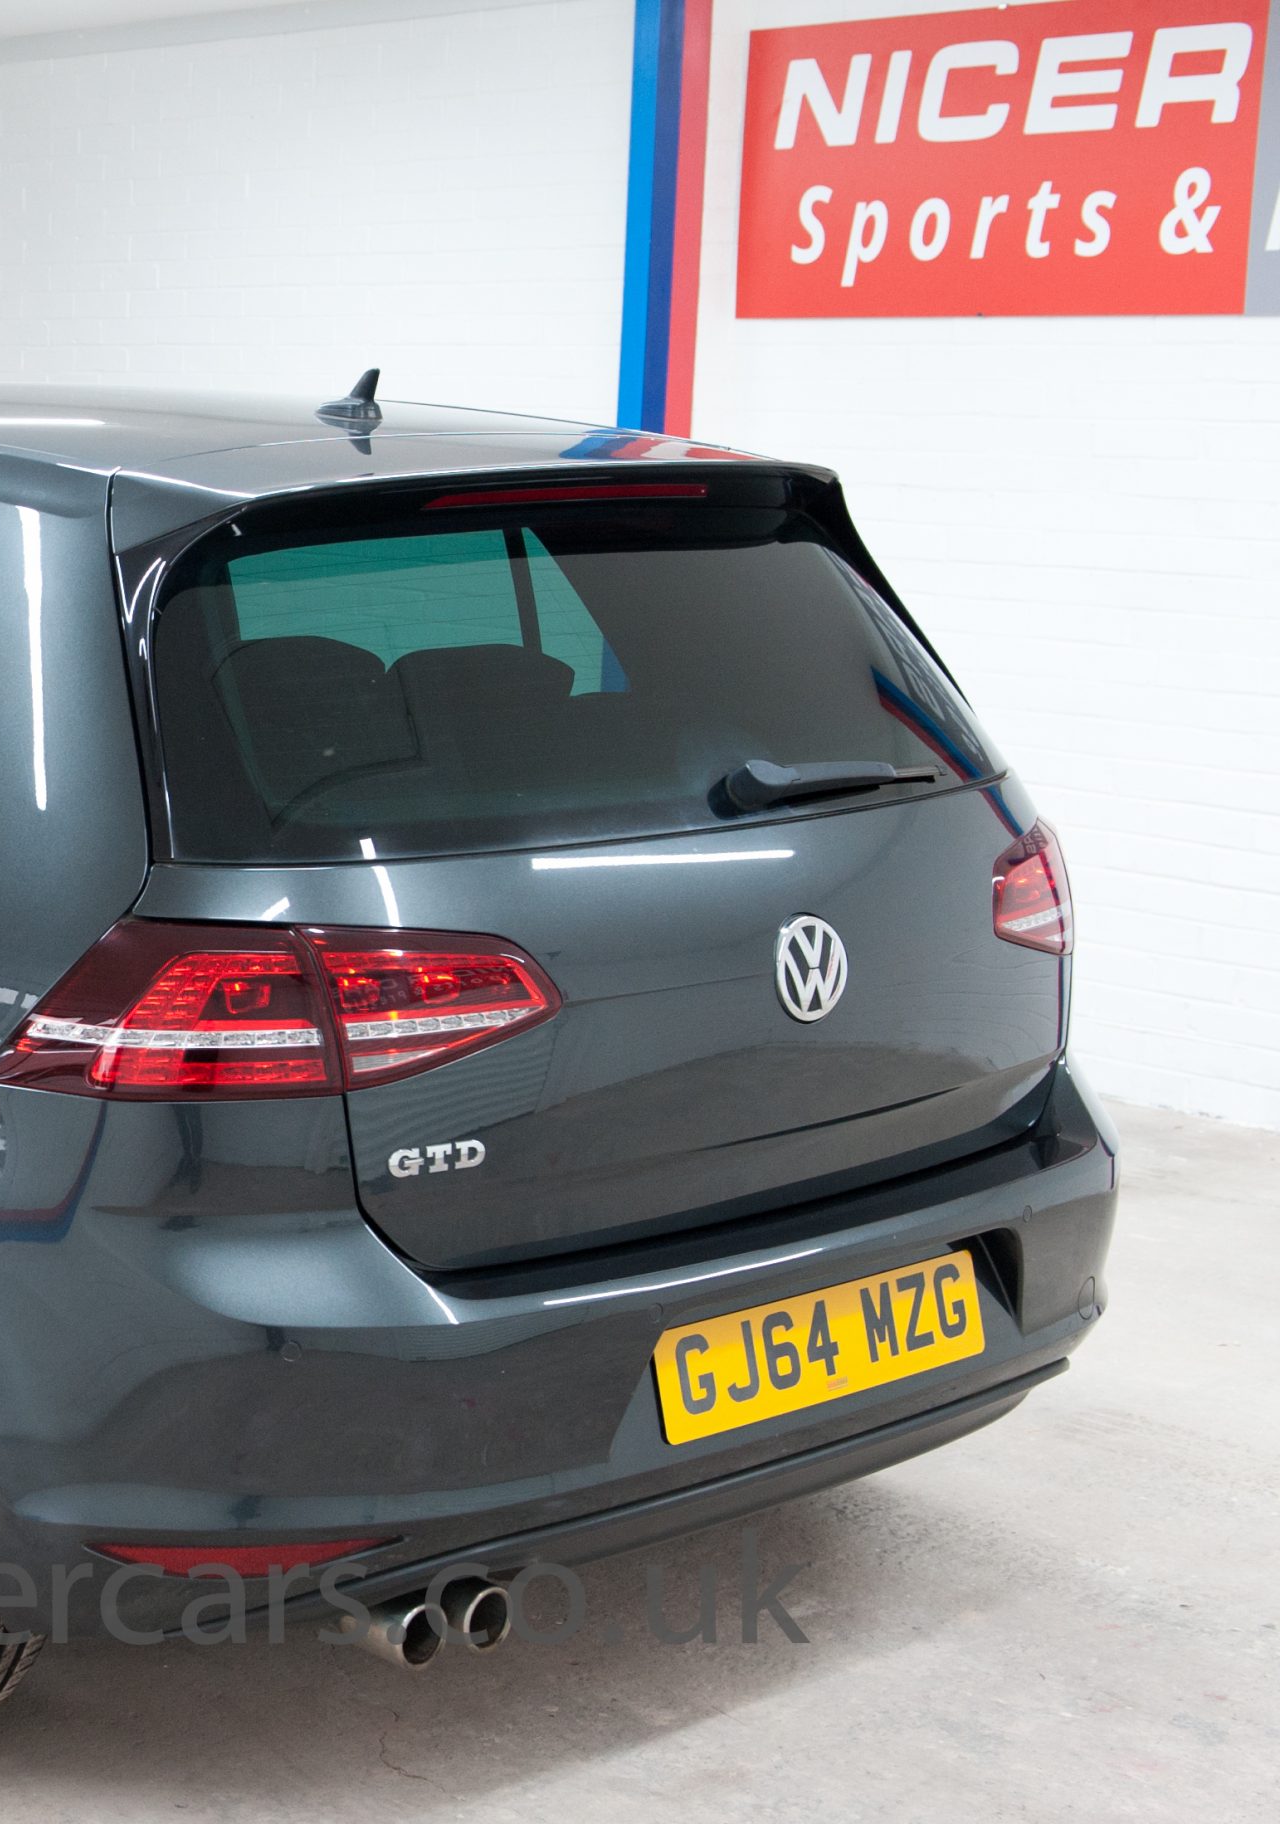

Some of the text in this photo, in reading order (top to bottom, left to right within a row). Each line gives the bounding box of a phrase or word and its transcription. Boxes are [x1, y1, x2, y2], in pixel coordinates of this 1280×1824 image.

[774, 22, 1253, 150] NICER
[790, 180, 1117, 288] Sports
[1158, 166, 1222, 255] &
[387, 1138, 486, 1178] GTD
[673, 1262, 967, 1417] GJ64 MZG
